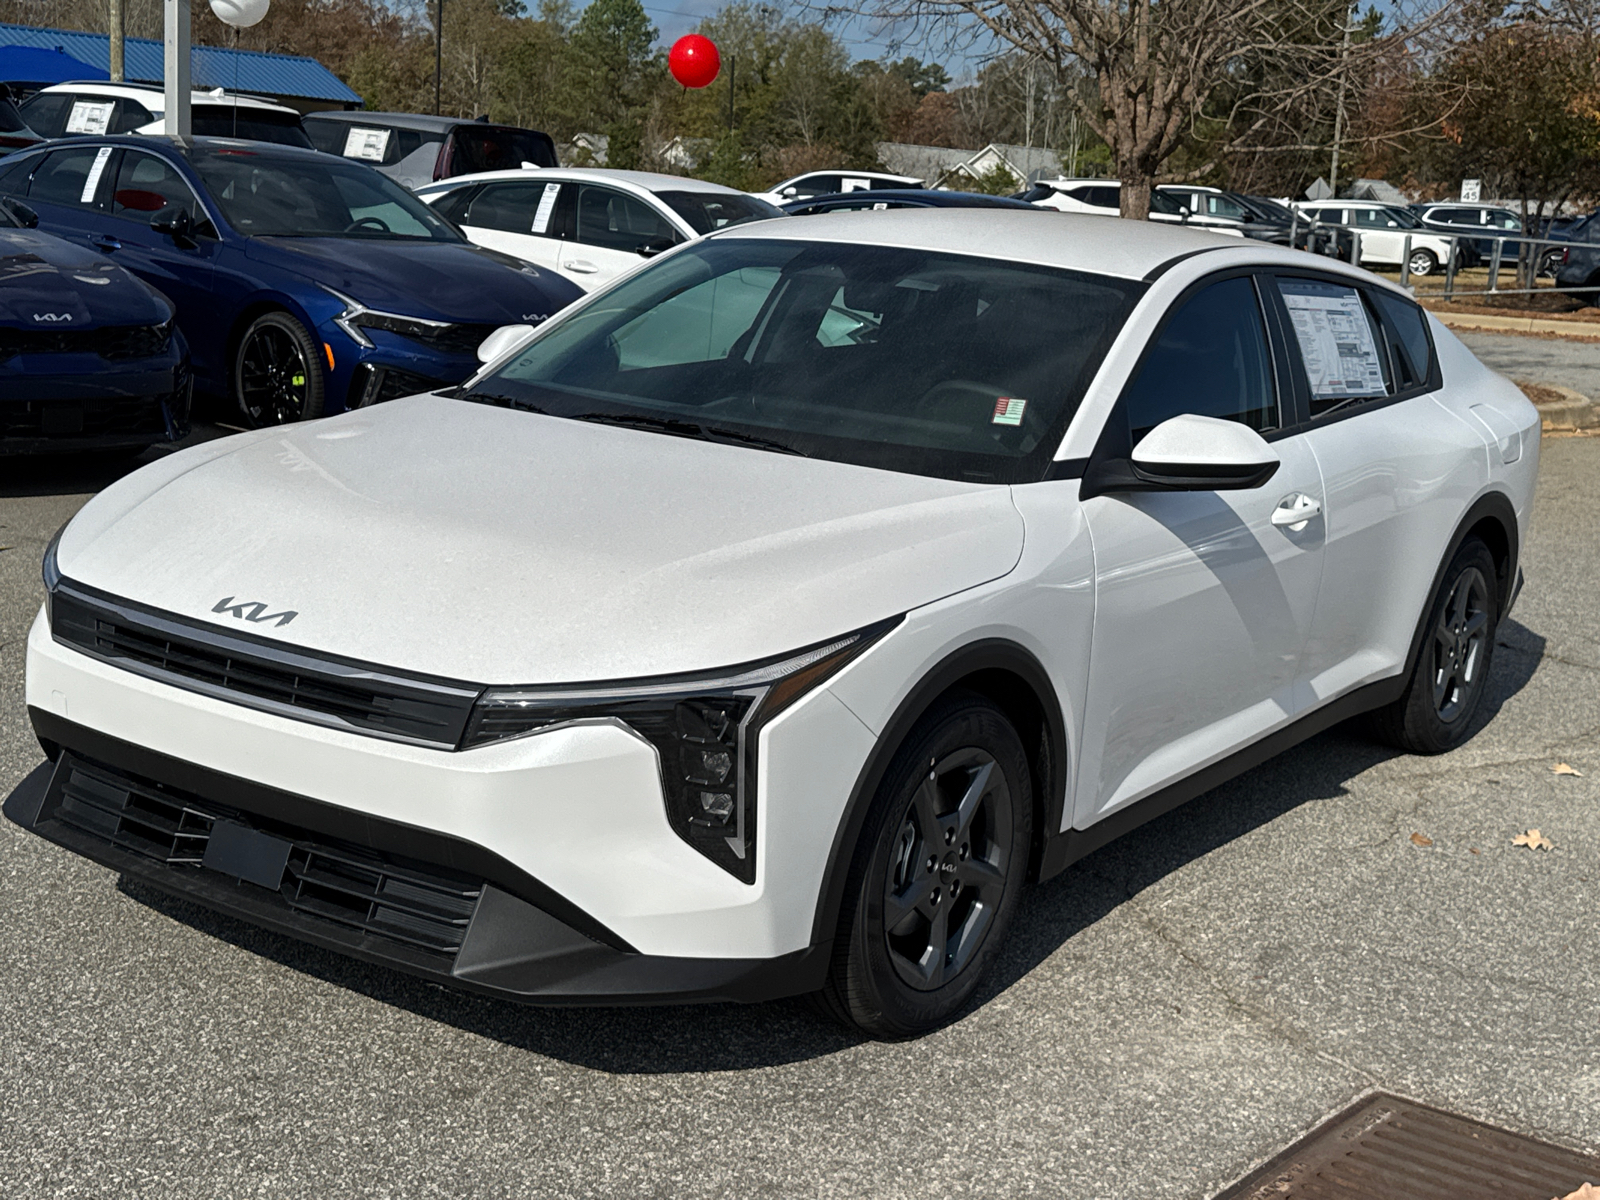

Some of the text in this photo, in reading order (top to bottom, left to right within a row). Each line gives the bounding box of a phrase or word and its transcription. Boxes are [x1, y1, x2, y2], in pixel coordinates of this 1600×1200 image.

[1463, 191, 1477, 201] 45
[33, 313, 73, 321] KIA
[211, 596, 299, 628] KIA
[941, 862, 958, 873] KIA
